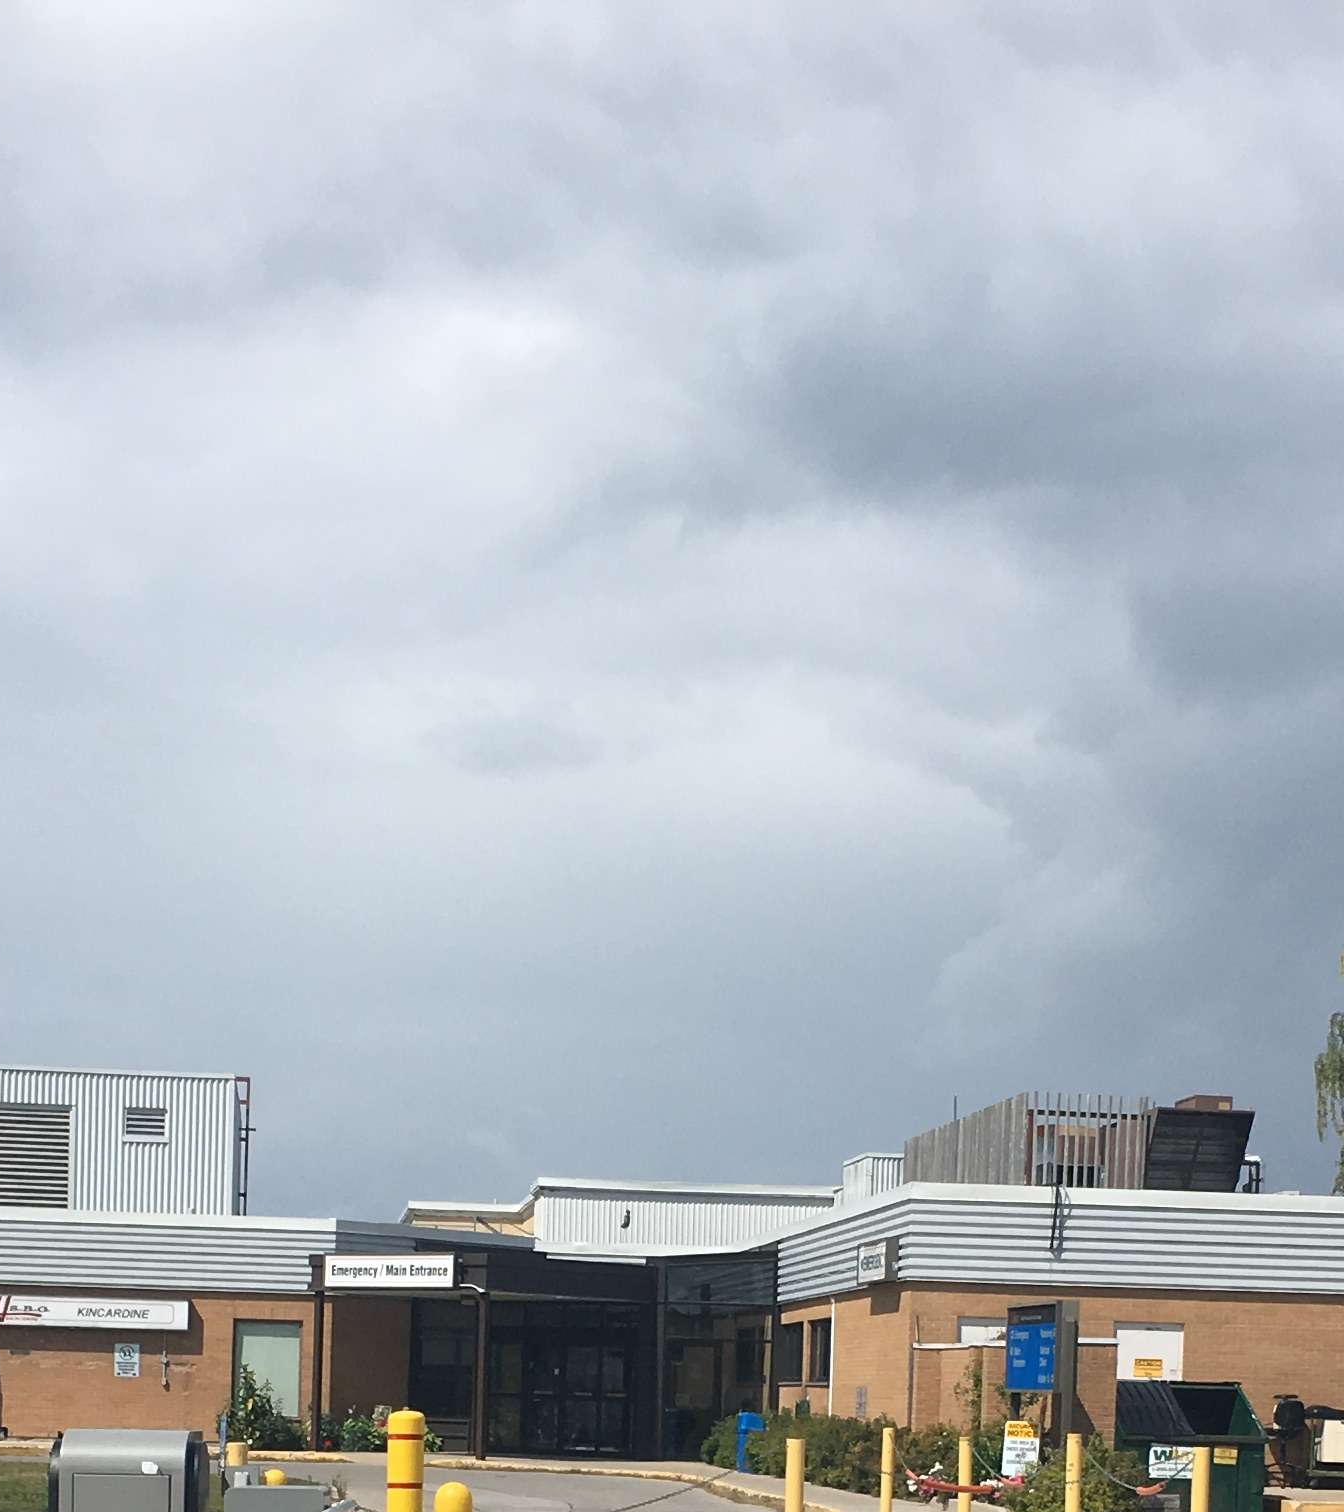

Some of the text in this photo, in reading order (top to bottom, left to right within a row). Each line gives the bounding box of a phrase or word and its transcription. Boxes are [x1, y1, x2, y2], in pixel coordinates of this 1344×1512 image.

[331, 1264, 378, 1278] Emergency
[385, 1264, 407, 1276] Main
[409, 1264, 448, 1276] Entrance
[76, 1306, 150, 1319] KINCARDINE
